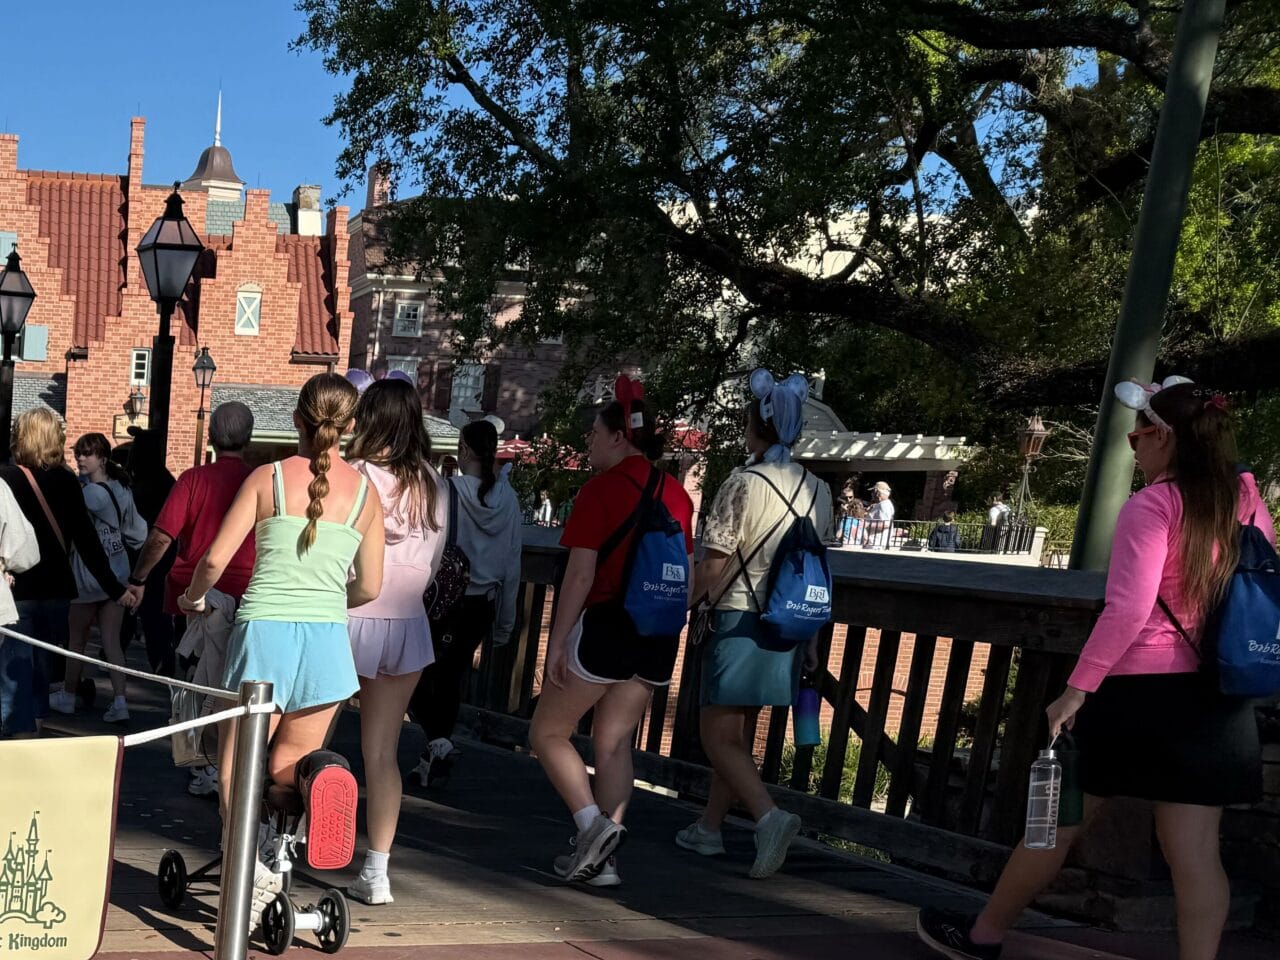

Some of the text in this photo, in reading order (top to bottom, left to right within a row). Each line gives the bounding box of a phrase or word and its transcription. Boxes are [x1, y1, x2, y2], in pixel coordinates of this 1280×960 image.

[660, 583, 680, 597] Rogers
[786, 600, 801, 610] Bob
[801, 603, 822, 616] Rogers
[9, 933, 67, 951] Kingdom
